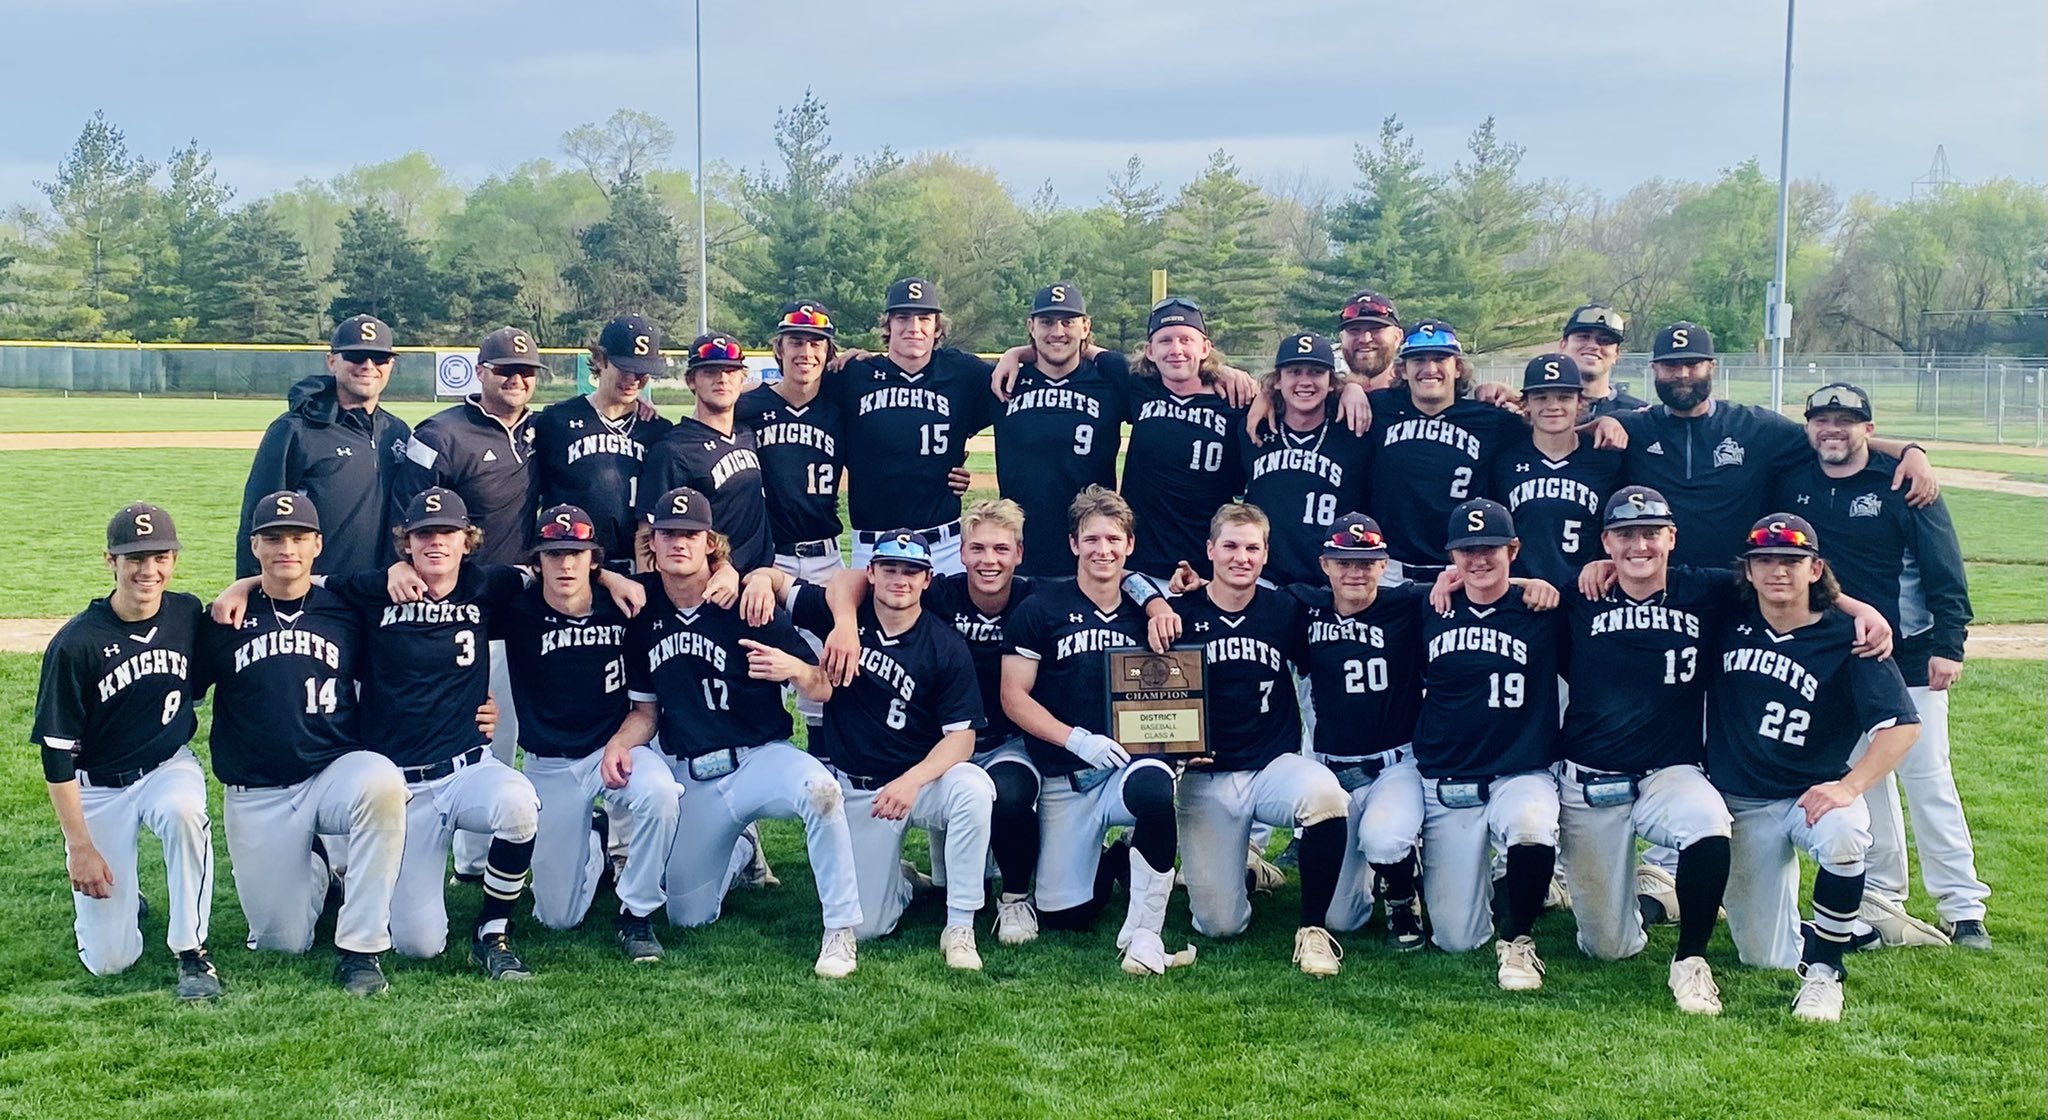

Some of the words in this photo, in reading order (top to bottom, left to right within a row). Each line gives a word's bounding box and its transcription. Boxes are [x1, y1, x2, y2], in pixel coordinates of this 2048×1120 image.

[908, 283, 922, 299] S
[1051, 287, 1065, 302] S
[361, 322, 377, 341] S
[513, 335, 529, 353] S
[635, 336, 649, 355] S
[1297, 337, 1312, 353] S
[1673, 330, 1688, 348] S
[1545, 362, 1559, 380] S
[859, 387, 949, 416] KNIGHTS
[1006, 387, 1100, 418] KNIGHTS
[1138, 400, 1227, 437] KNIGHTS
[567, 433, 645, 465] KNIGHT
[920, 424, 949, 455] 15
[1074, 425, 1093, 455] 9
[1385, 419, 1480, 459] KNIGHTS
[1190, 440, 1223, 471] 10
[1253, 449, 1342, 487] KNIGHTS
[807, 464, 833, 494] 12
[1450, 467, 1472, 498] 2
[277, 497, 293, 514] S
[426, 495, 441, 512] S
[673, 496, 688, 513] S
[1303, 492, 1337, 526] 18
[1508, 478, 1598, 515] KNIGHTS
[136, 514, 153, 535] S
[556, 514, 570, 531] S
[1349, 524, 1365, 542] S
[1469, 511, 1484, 531] S
[1562, 520, 1581, 552] 5
[380, 602, 480, 628] KNIGHTS
[1591, 605, 1699, 638] KNIGHTS
[235, 629, 339, 672] KNIGHTS
[455, 630, 475, 666] 3
[540, 625, 627, 656] KNIGHT
[648, 633, 726, 672] KNIGHTS
[1429, 627, 1526, 664] KNIGHTS
[98, 648, 188, 703] KNIGHTS
[1344, 658, 1388, 693] 20
[1665, 647, 1697, 683] 13
[1724, 649, 1818, 703] KNIGHTS
[305, 678, 337, 713] 14
[702, 679, 729, 710] 17
[1125, 691, 1189, 700] CHAMPION
[1260, 681, 1274, 713] 7
[1488, 673, 1524, 707] 19
[162, 690, 181, 725] 8
[886, 698, 906, 730] 6
[1140, 713, 1177, 721] DISTRICT
[1759, 701, 1811, 746] 22
